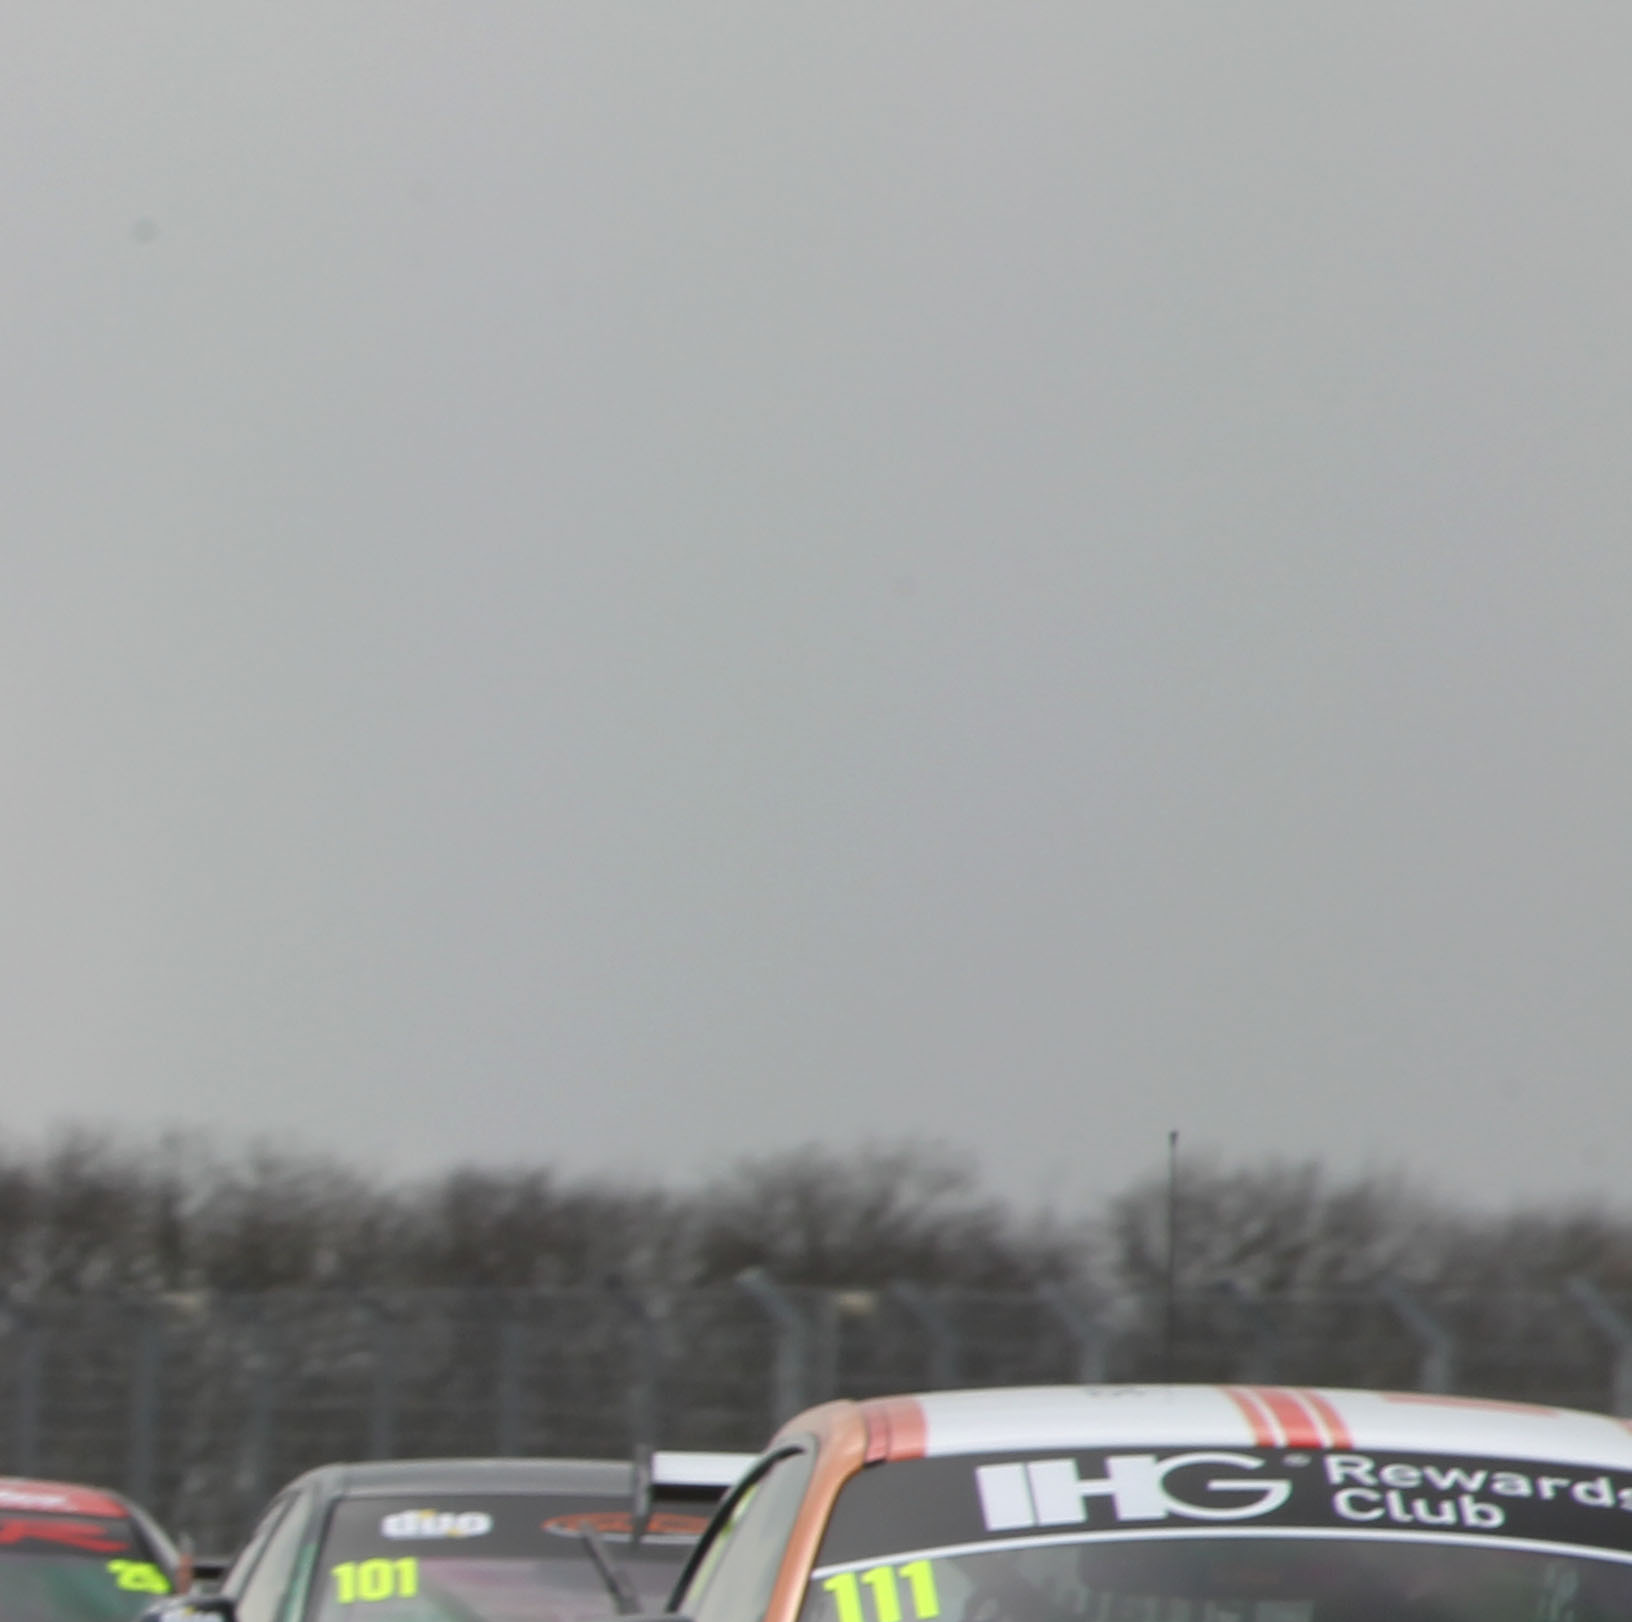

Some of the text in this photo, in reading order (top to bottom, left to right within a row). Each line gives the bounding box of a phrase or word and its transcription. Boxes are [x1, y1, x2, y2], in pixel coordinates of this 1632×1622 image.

[976, 1452, 1292, 1531] IHG
[1333, 1487, 1506, 1529] Club
[331, 1557, 418, 1604] 101
